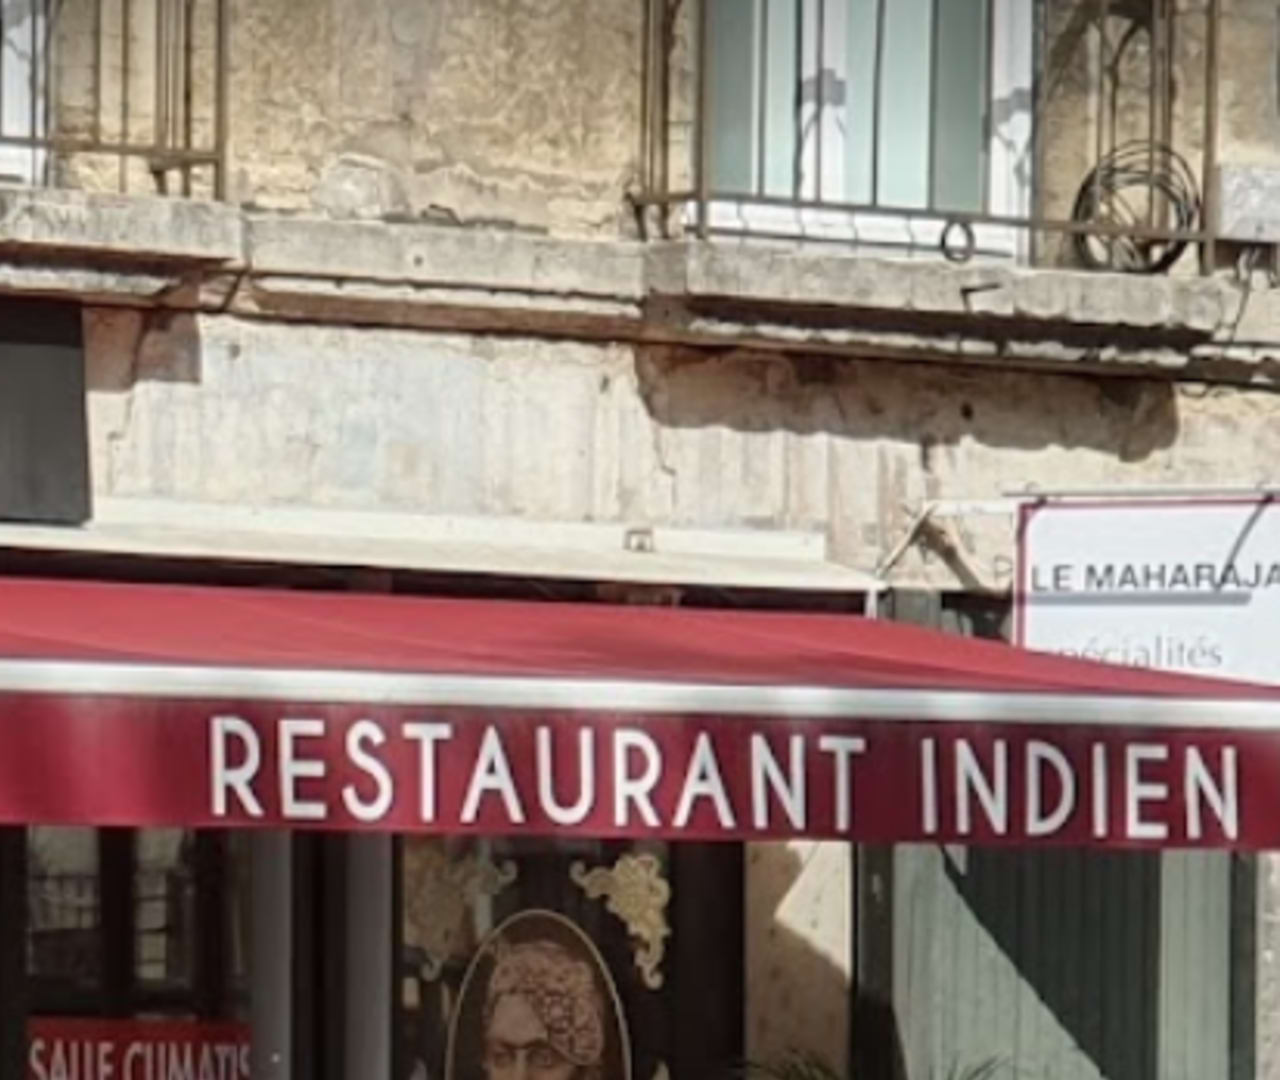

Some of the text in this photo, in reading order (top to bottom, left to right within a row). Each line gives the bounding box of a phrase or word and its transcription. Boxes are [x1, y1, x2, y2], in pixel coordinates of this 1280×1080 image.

[1032, 564, 1072, 591] LE
[209, 718, 1238, 840] RESTAURANT INDIEN
